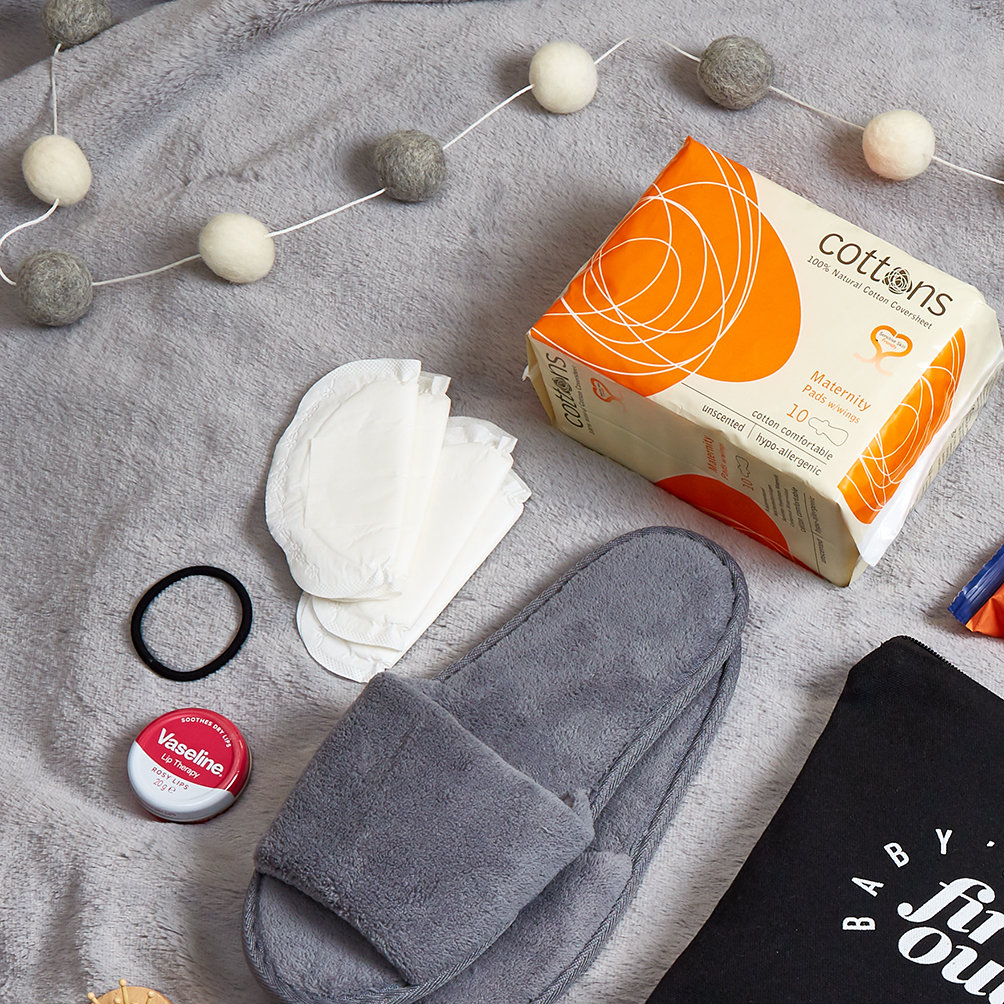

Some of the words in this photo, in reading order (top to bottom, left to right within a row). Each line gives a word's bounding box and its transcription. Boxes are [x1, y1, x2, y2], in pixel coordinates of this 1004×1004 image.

[807, 255, 830, 273] 100%
[832, 268, 863, 289] Natural
[863, 285, 889, 304] Cotton
[890, 300, 933, 330] Coversheet
[801, 384, 827, 405] Pads
[827, 400, 861, 425] w/wings
[810, 370, 872, 412] Maternity
[701, 403, 746, 432] unscented
[786, 403, 809, 423] 10
[751, 410, 780, 430] cotton
[780, 425, 834, 461] comfortable
[755, 433, 823, 476] hypo-allergenic
[157, 727, 224, 776] Vaseline
[181, 716, 212, 727] SOOTHES
[212, 724, 224, 735] DRY
[222, 733, 232, 748] LIPS
[152, 766, 171, 780] ROSY
[172, 777, 189, 790] LIPS
[161, 753, 173, 764] Lip
[173, 758, 200, 779] Therapy
